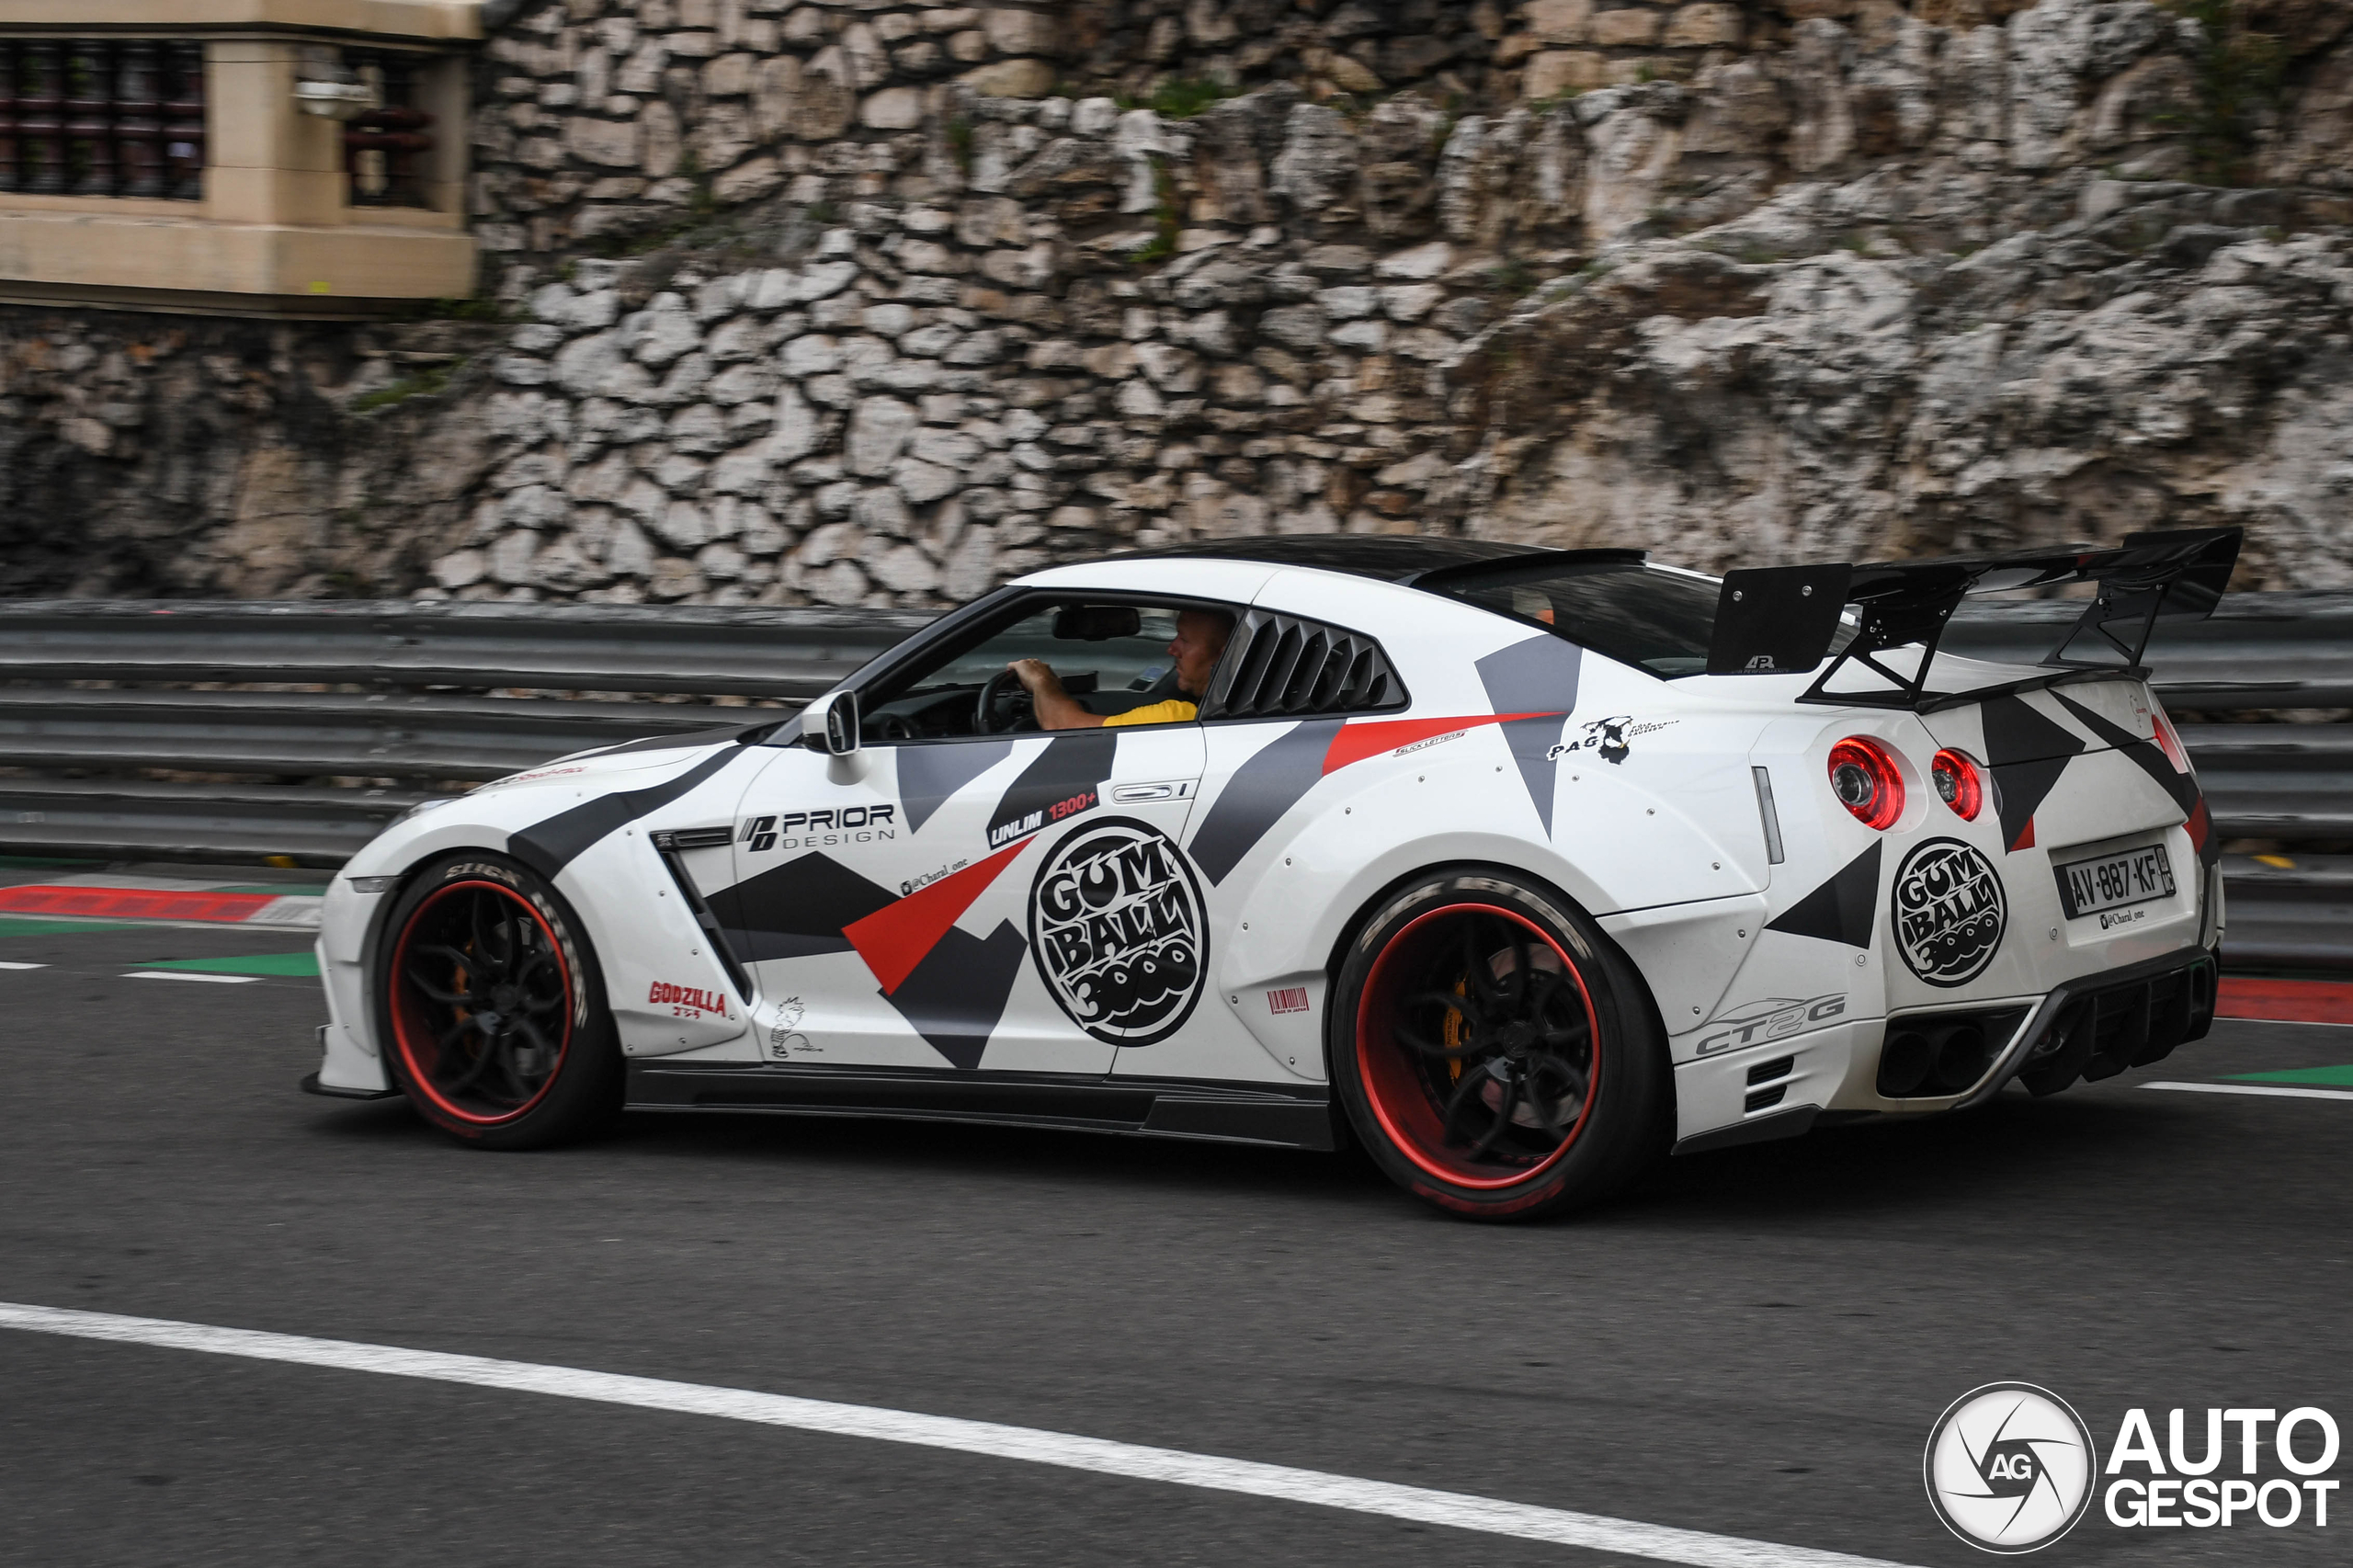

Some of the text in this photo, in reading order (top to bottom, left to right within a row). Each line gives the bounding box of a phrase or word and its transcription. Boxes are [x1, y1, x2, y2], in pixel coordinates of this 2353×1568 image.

[1400, 743, 1423, 754] SLICK
[1548, 735, 1599, 759] PAG
[783, 804, 894, 834] PRIOR
[783, 829, 895, 849] DESIGN
[991, 791, 1097, 846] UNLIM 1300+
[1039, 837, 1176, 923] GUM
[1898, 847, 1986, 910] GUM
[2071, 855, 2156, 908] AV-887-KF
[1044, 880, 1196, 978] BALL
[1902, 873, 1999, 948] BALL
[1914, 913, 2000, 975] 3000
[649, 981, 727, 1017] GODZILLA
[1064, 938, 1198, 1024] 3000
[1696, 995, 1846, 1055] CT2G
